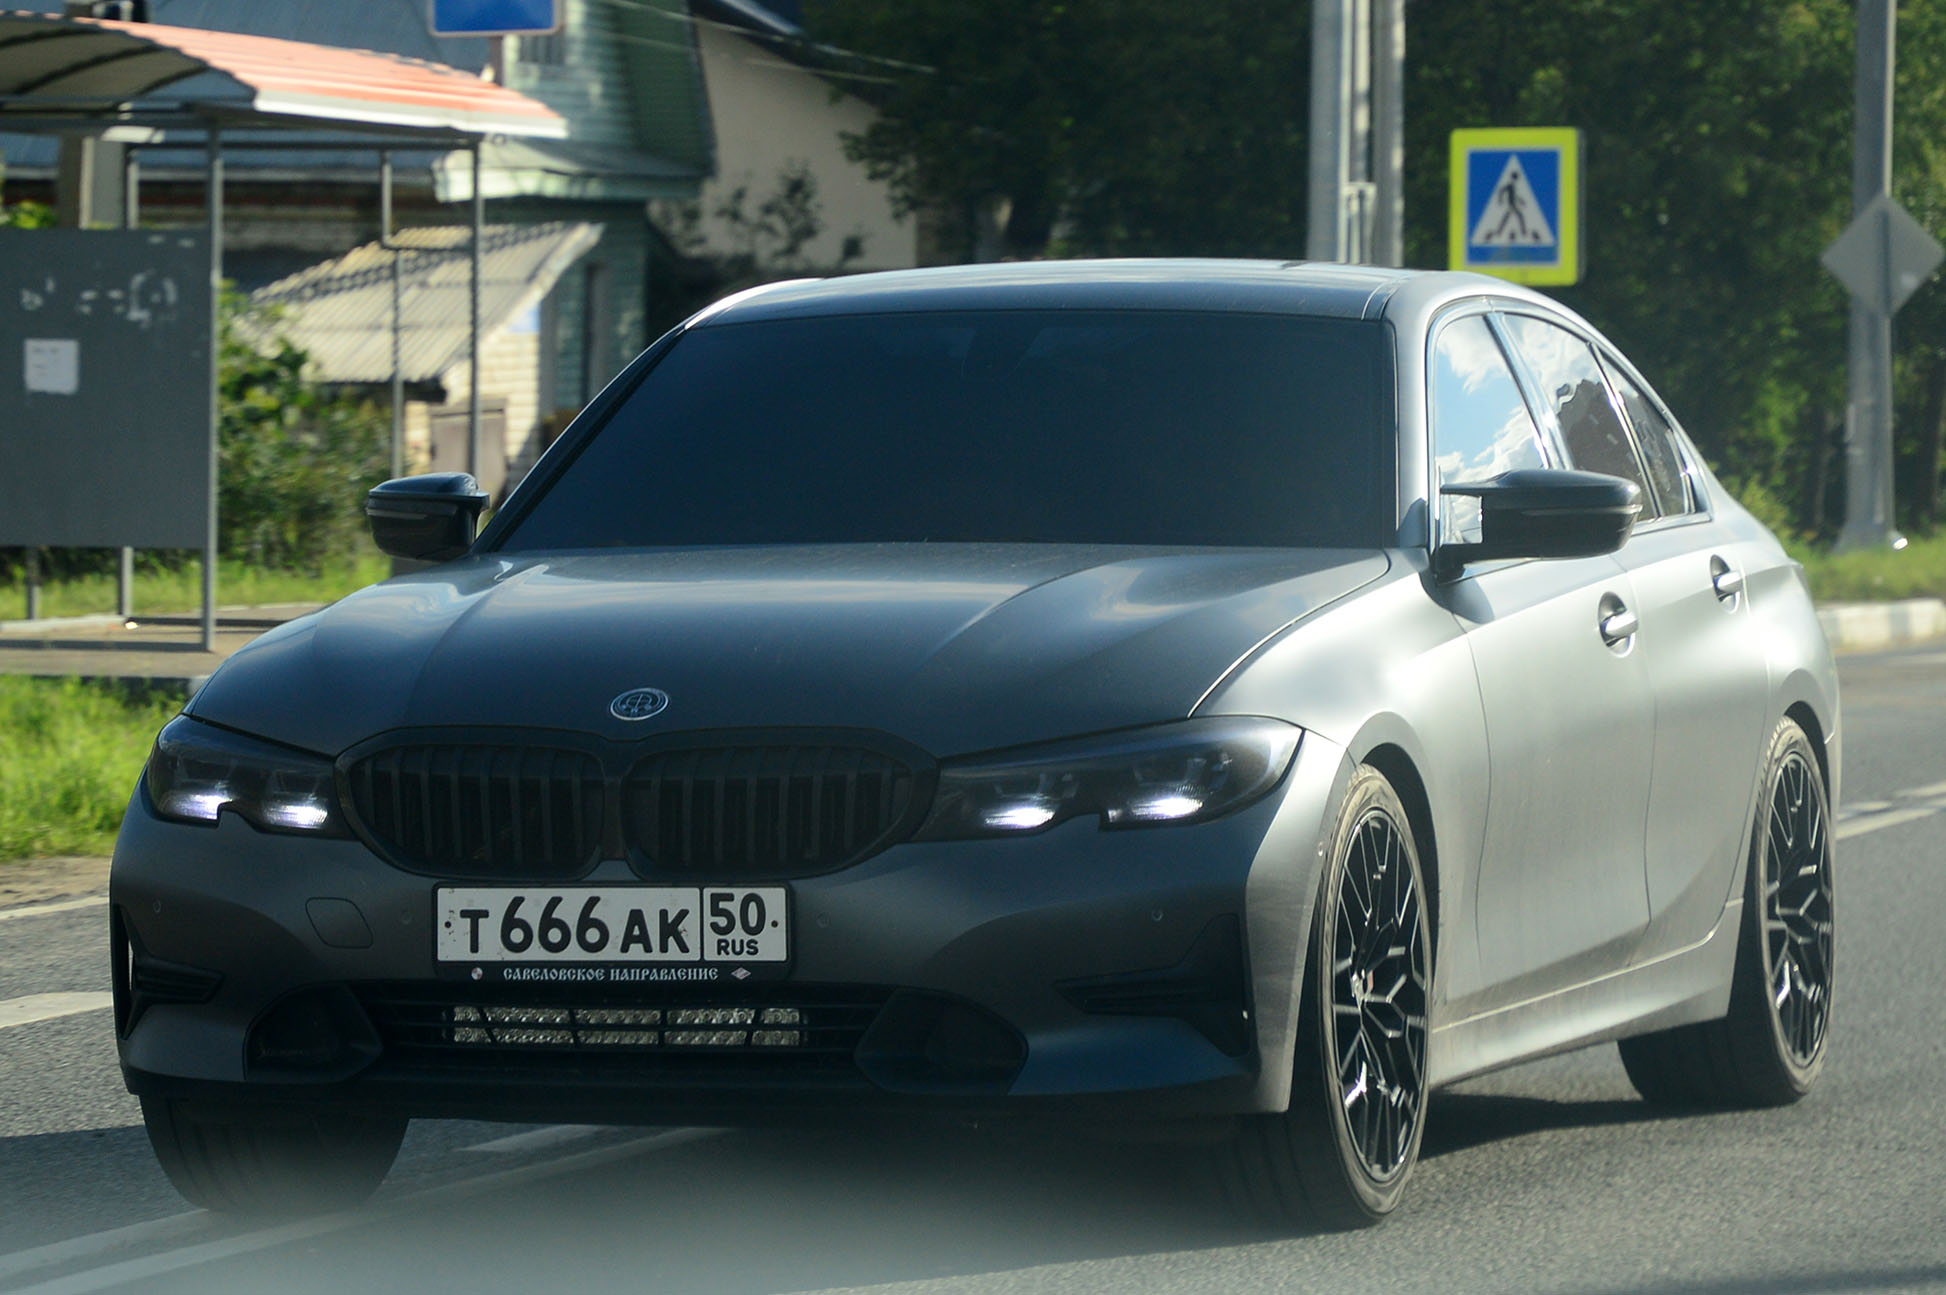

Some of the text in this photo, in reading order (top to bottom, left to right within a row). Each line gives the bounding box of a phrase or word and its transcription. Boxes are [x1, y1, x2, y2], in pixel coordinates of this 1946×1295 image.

[709, 893, 767, 936] 50
[716, 939, 759, 955] RUS
[503, 967, 719, 981] САВЕЛОВСКОЕ НАПРАВЛЕНИЕ
